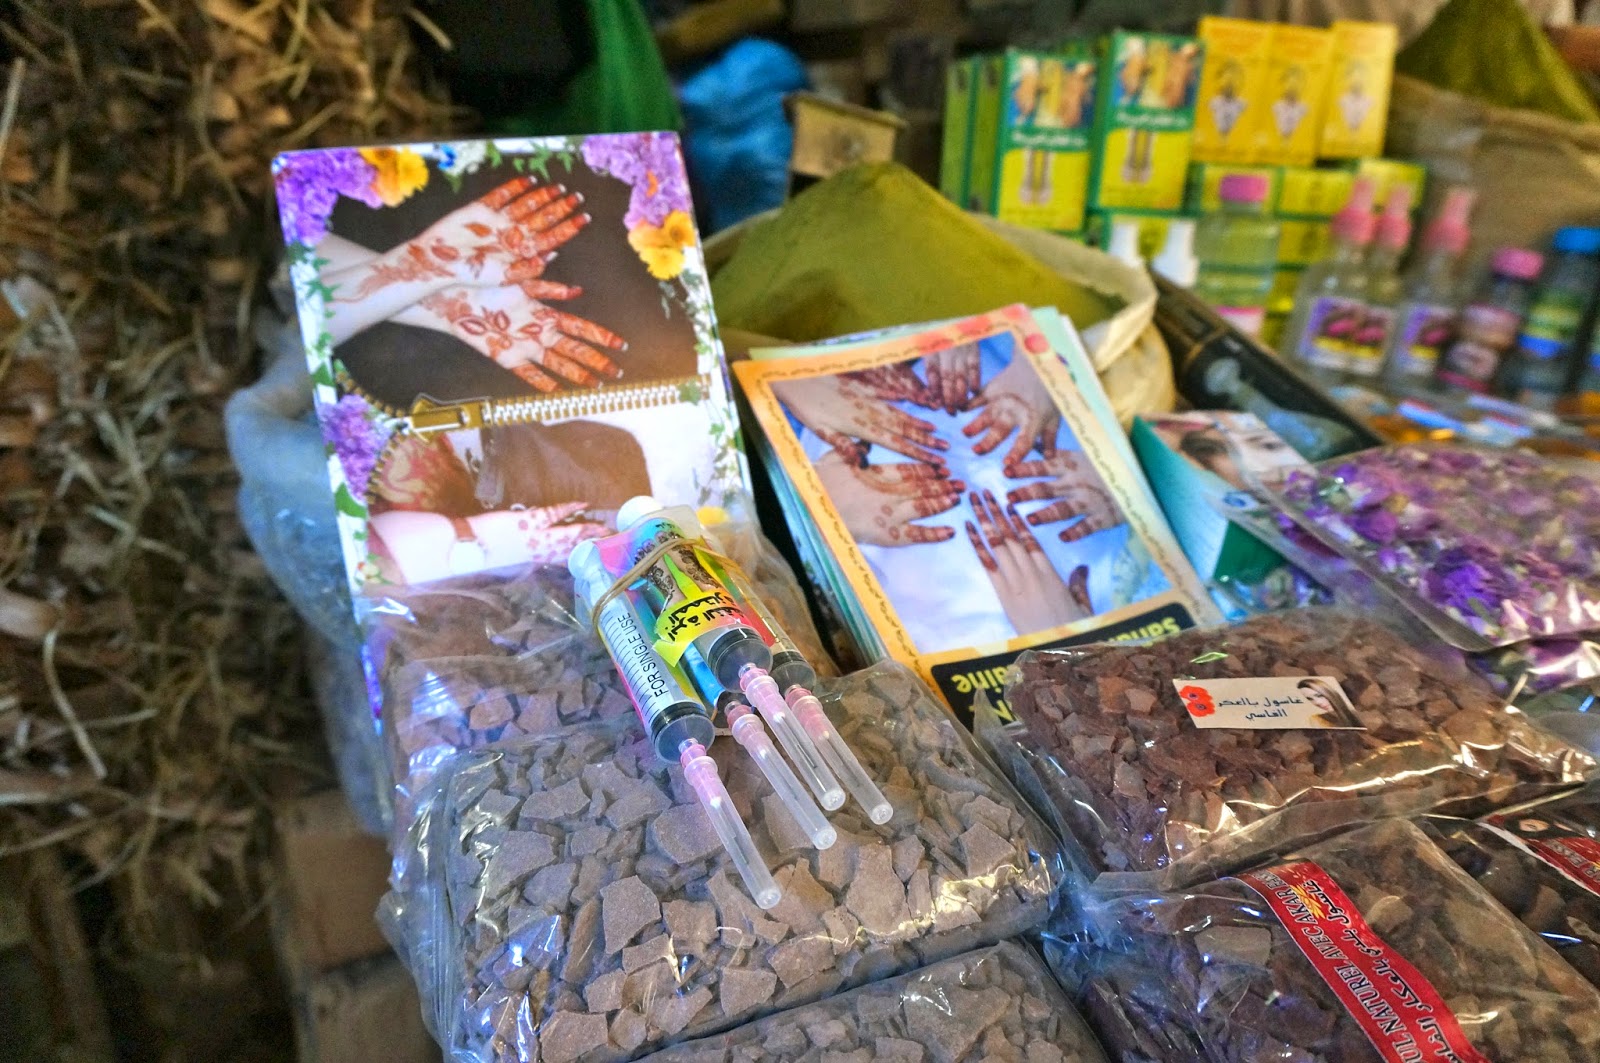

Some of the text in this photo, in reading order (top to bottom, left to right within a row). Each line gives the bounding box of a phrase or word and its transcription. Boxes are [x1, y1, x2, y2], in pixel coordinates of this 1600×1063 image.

[618, 612, 669, 697] FOR SINGLE USE
[1275, 886, 1425, 1063] UL NATUREL AVEC AKAR
[1303, 879, 1466, 1063] غاسول بلدي بالعكار الفاس
